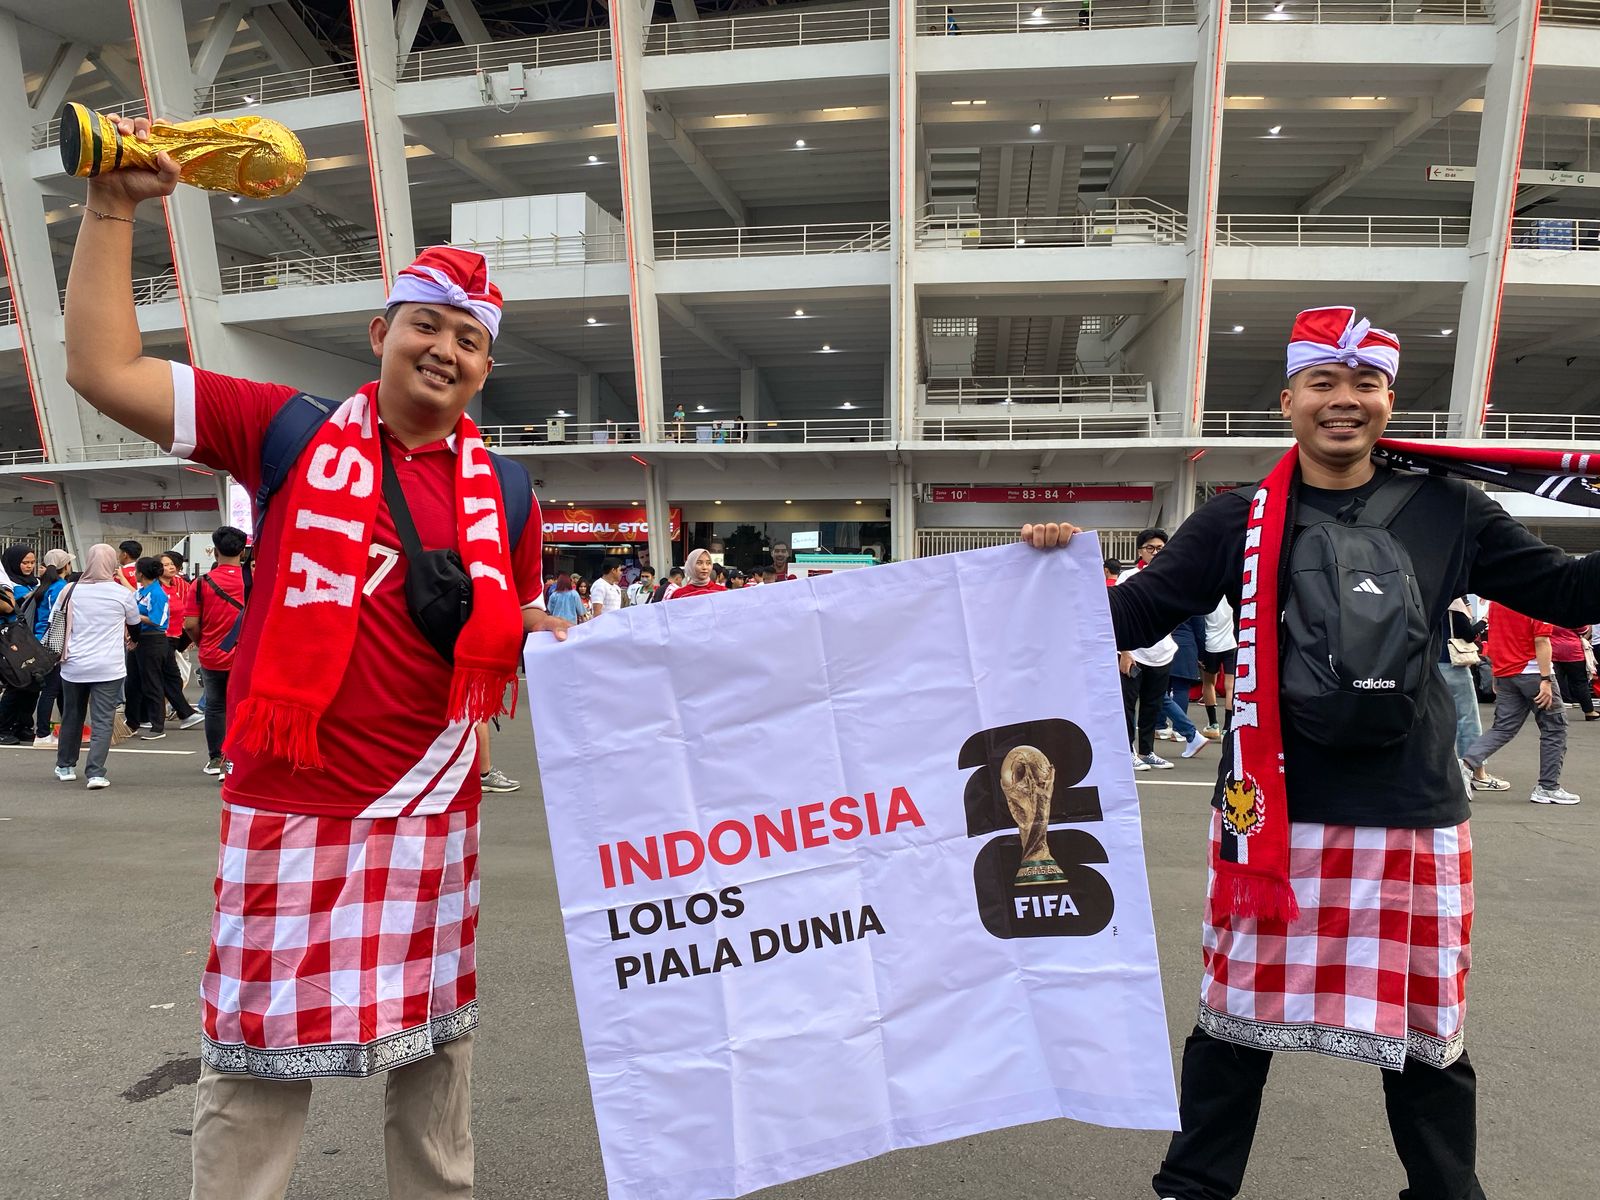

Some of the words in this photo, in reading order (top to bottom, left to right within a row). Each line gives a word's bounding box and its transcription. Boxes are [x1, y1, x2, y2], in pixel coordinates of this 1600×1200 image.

[1577, 174, 1585, 184] G
[542, 522, 616, 533] OFFICIAL
[362, 542, 400, 597] 7
[1352, 677, 1396, 689] adidas
[598, 786, 926, 889] INDONESIA
[607, 886, 745, 941] LOLOS
[1013, 894, 1080, 919] FIFA
[614, 937, 743, 990] PIALA
[749, 904, 887, 963] DUNIA
